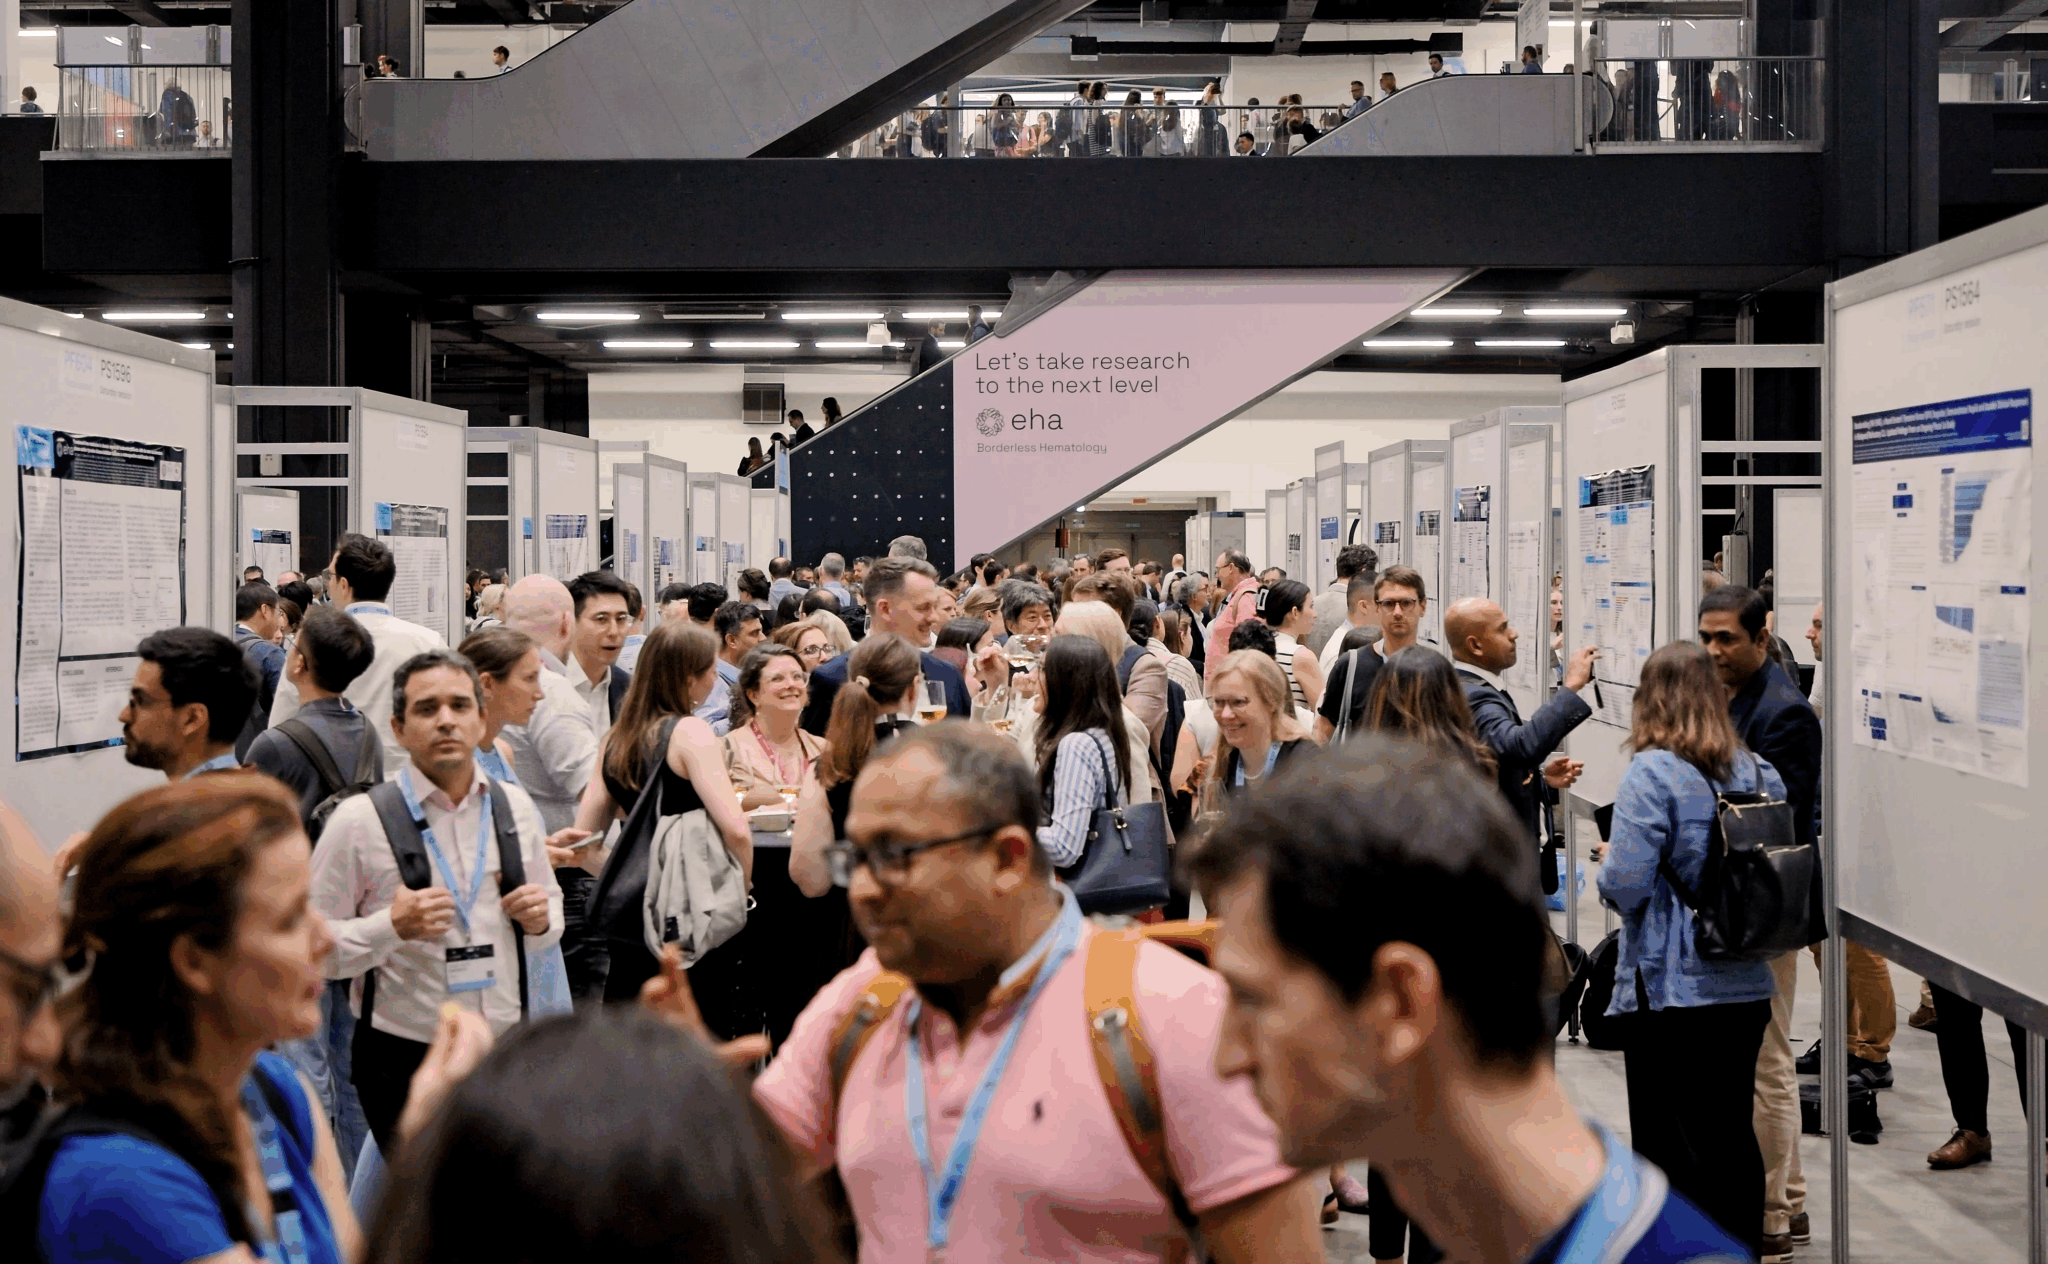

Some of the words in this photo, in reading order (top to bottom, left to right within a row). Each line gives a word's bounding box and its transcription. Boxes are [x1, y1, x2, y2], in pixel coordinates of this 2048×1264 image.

[1945, 279, 1980, 311] PS1564
[976, 352, 1029, 370] Let’s
[1036, 352, 1084, 370] take
[1092, 352, 1190, 370] research
[101, 359, 131, 384] PS1596
[975, 376, 999, 394] to
[1006, 376, 1044, 393] the
[1052, 376, 1102, 393] next
[1109, 375, 1158, 393] level
[1011, 408, 1063, 430] eha
[977, 442, 1037, 453] Borderless
[1039, 442, 1107, 454] Hematology
